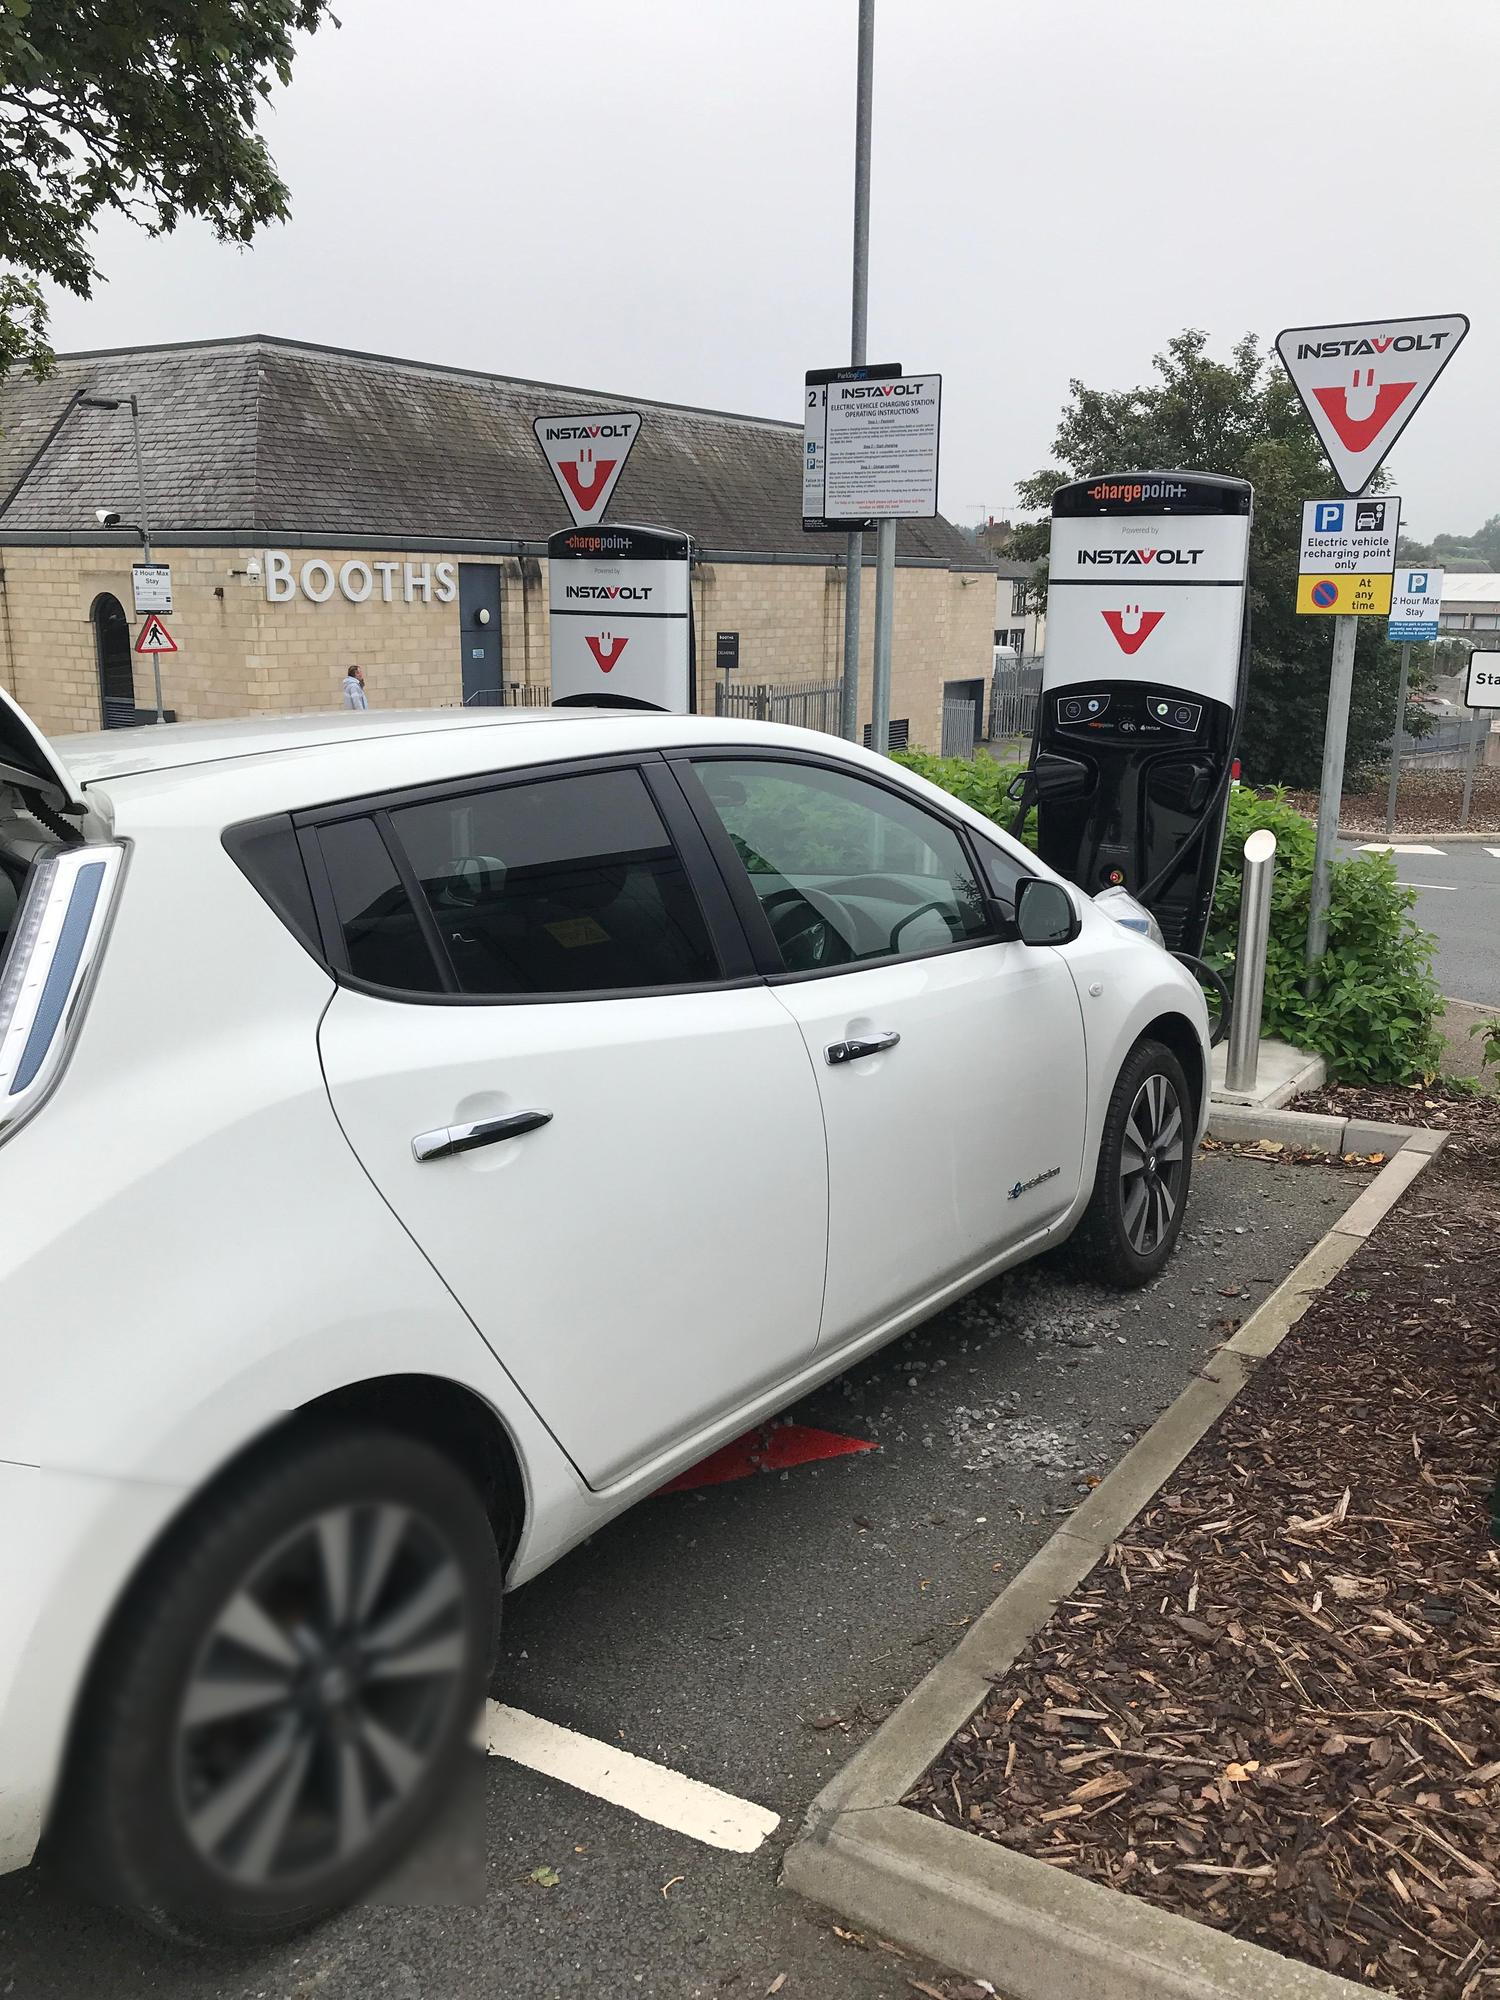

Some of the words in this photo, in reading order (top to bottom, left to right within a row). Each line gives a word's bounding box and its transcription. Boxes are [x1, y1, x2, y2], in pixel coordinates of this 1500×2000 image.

[1297, 332, 1450, 360] INSTAVOLT
[841, 383, 924, 399] INSTAVOLT
[808, 391, 817, 408] 2
[831, 402, 856, 411] ELECTRIC
[856, 401, 879, 410] VEHICLE
[879, 400, 910, 408] CHARGING
[910, 398, 935, 407] STATION
[845, 409, 877, 418] OPERATING
[877, 407, 920, 417] INSTRUCTIONS
[546, 424, 632, 440] INSTAVOLT
[1122, 526, 1149, 534] Powered
[1150, 526, 1159, 535] by
[1308, 537, 1348, 547] Electric
[1351, 537, 1389, 546] vehicle
[1077, 548, 1205, 565] INSTAVOLT
[1303, 549, 1359, 559] recharging
[1363, 548, 1391, 559] point
[1334, 560, 1357, 570] only
[264, 550, 457, 603] BOOTHS
[1359, 578, 1372, 588] At
[566, 585, 653, 600] INSTAVOLT
[1355, 591, 1374, 600] any
[1352, 601, 1375, 610] time
[1400, 597, 1421, 605] Hour
[1422, 597, 1439, 605] Max
[1405, 608, 1424, 617] Stay
